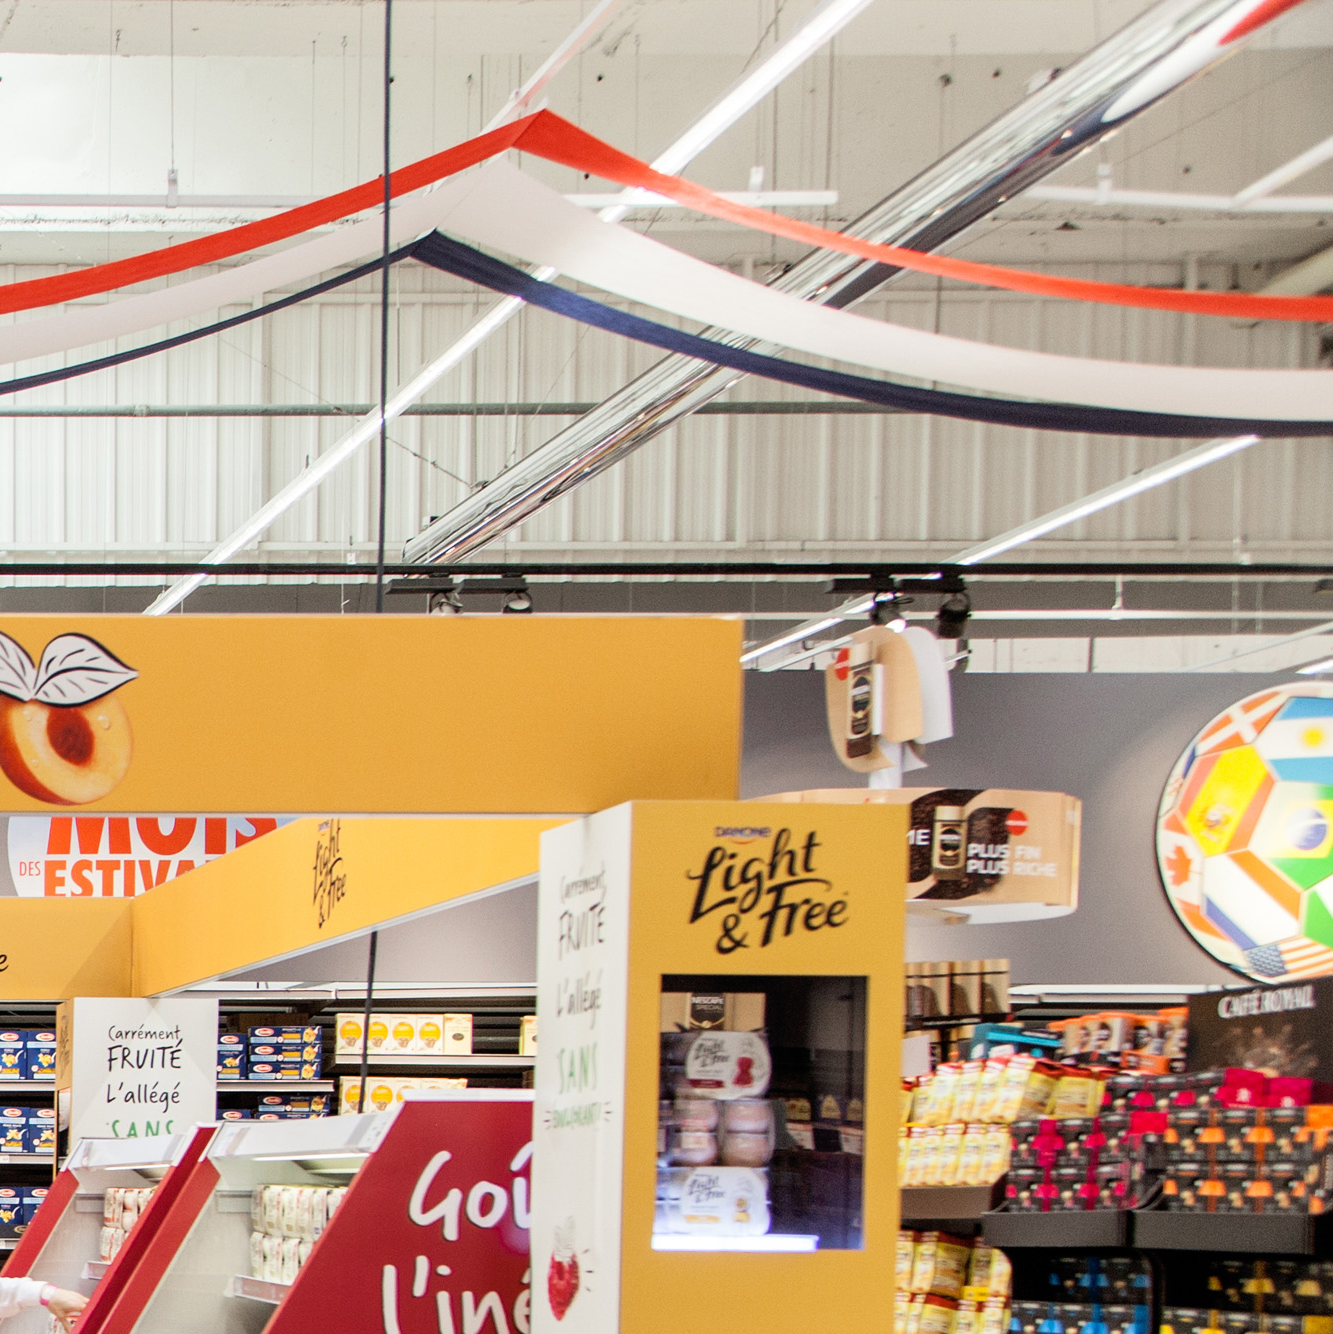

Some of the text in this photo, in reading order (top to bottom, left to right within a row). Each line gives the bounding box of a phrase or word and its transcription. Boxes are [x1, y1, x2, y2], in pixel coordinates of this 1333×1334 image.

[967, 844, 1010, 858] PLUS
[19, 861, 41, 876] DES
[687, 828, 822, 924] Light
[966, 859, 1010, 874] PLUS
[716, 878, 849, 955] & Free
[108, 1024, 182, 1041] Carrément
[107, 1038, 183, 1072] FRUITÉ
[107, 1082, 181, 1113] L'allégé
